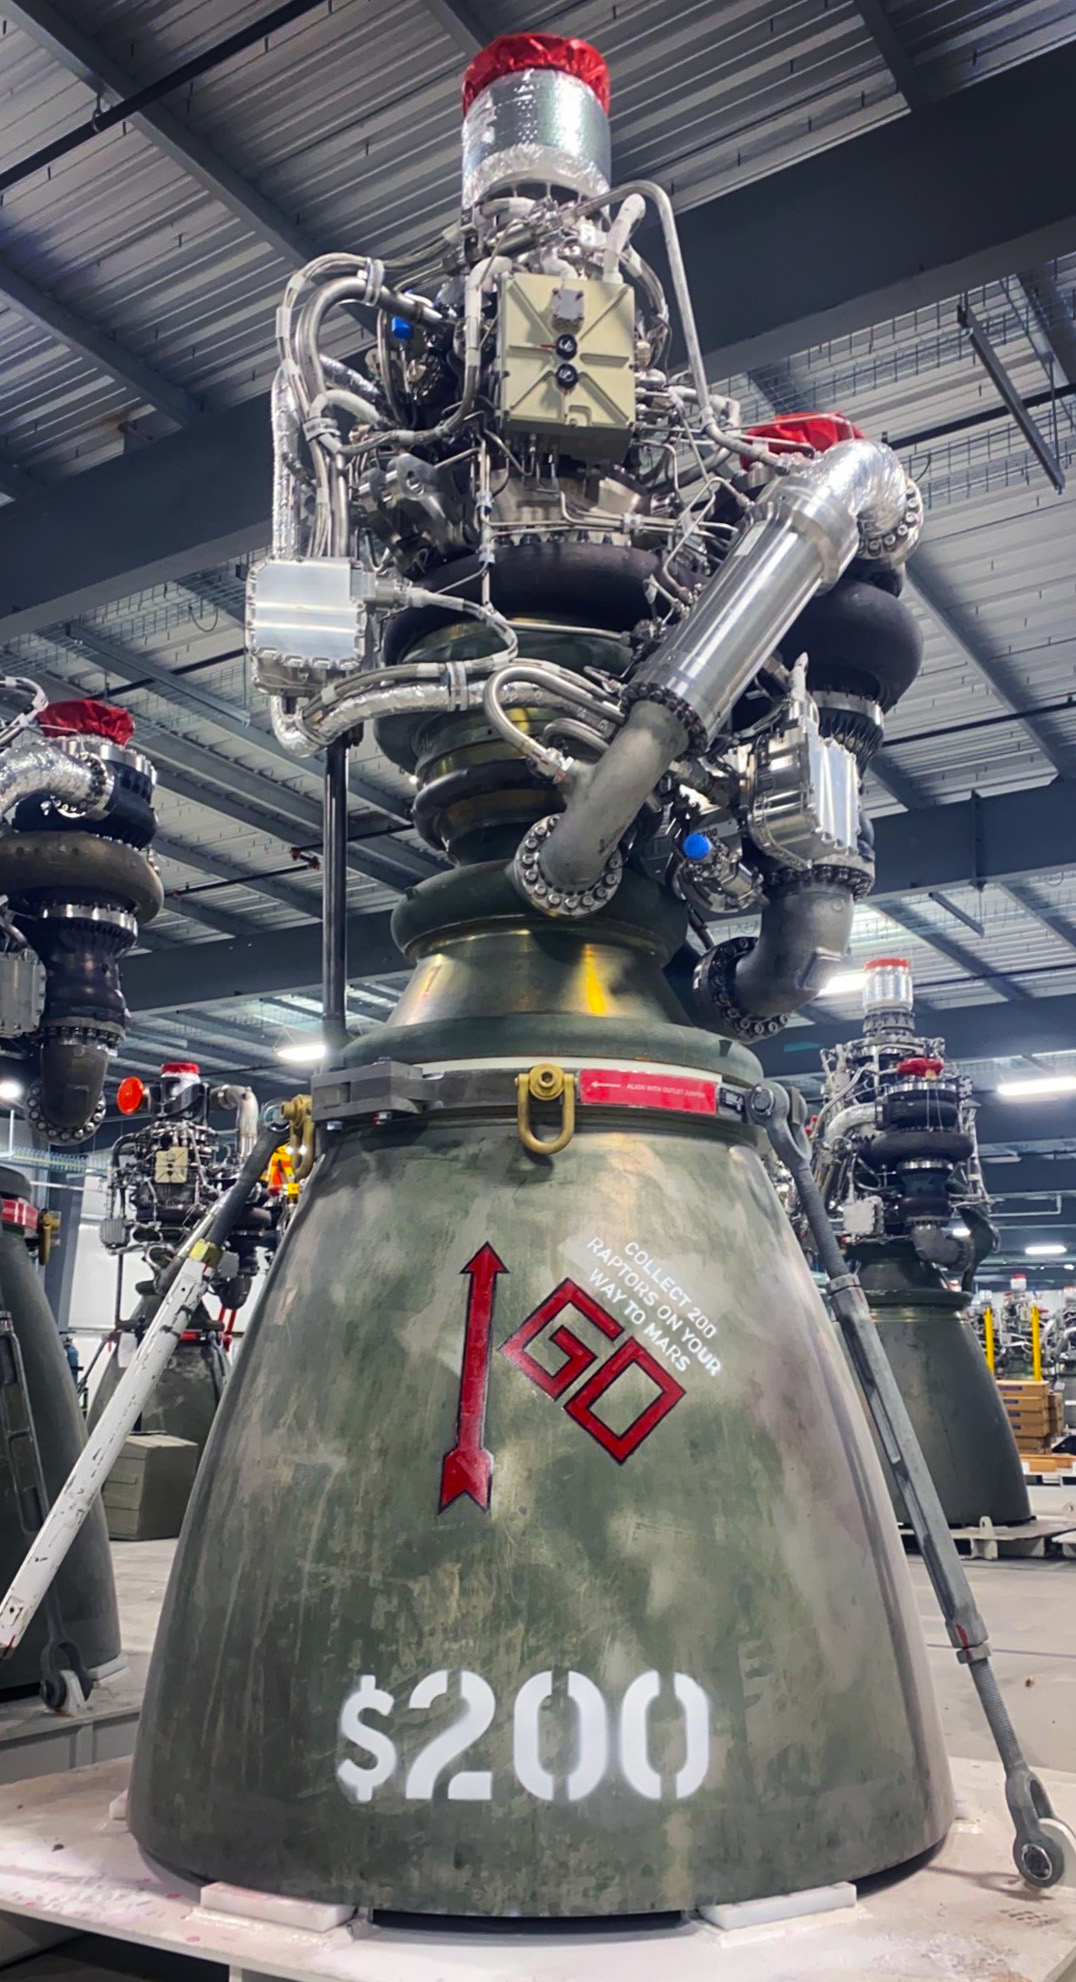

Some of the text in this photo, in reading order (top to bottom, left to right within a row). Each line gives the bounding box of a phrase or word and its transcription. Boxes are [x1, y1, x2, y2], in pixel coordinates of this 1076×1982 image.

[626, 1083, 646, 1091] ALIGN
[587, 1237, 722, 1376] RAPTORS ON YOUR
[589, 1268, 691, 1371] WAY TO MARS
[625, 1241, 717, 1338] COLLECT 200
[497, 1277, 687, 1466] GO
[337, 1669, 710, 1803] $200
